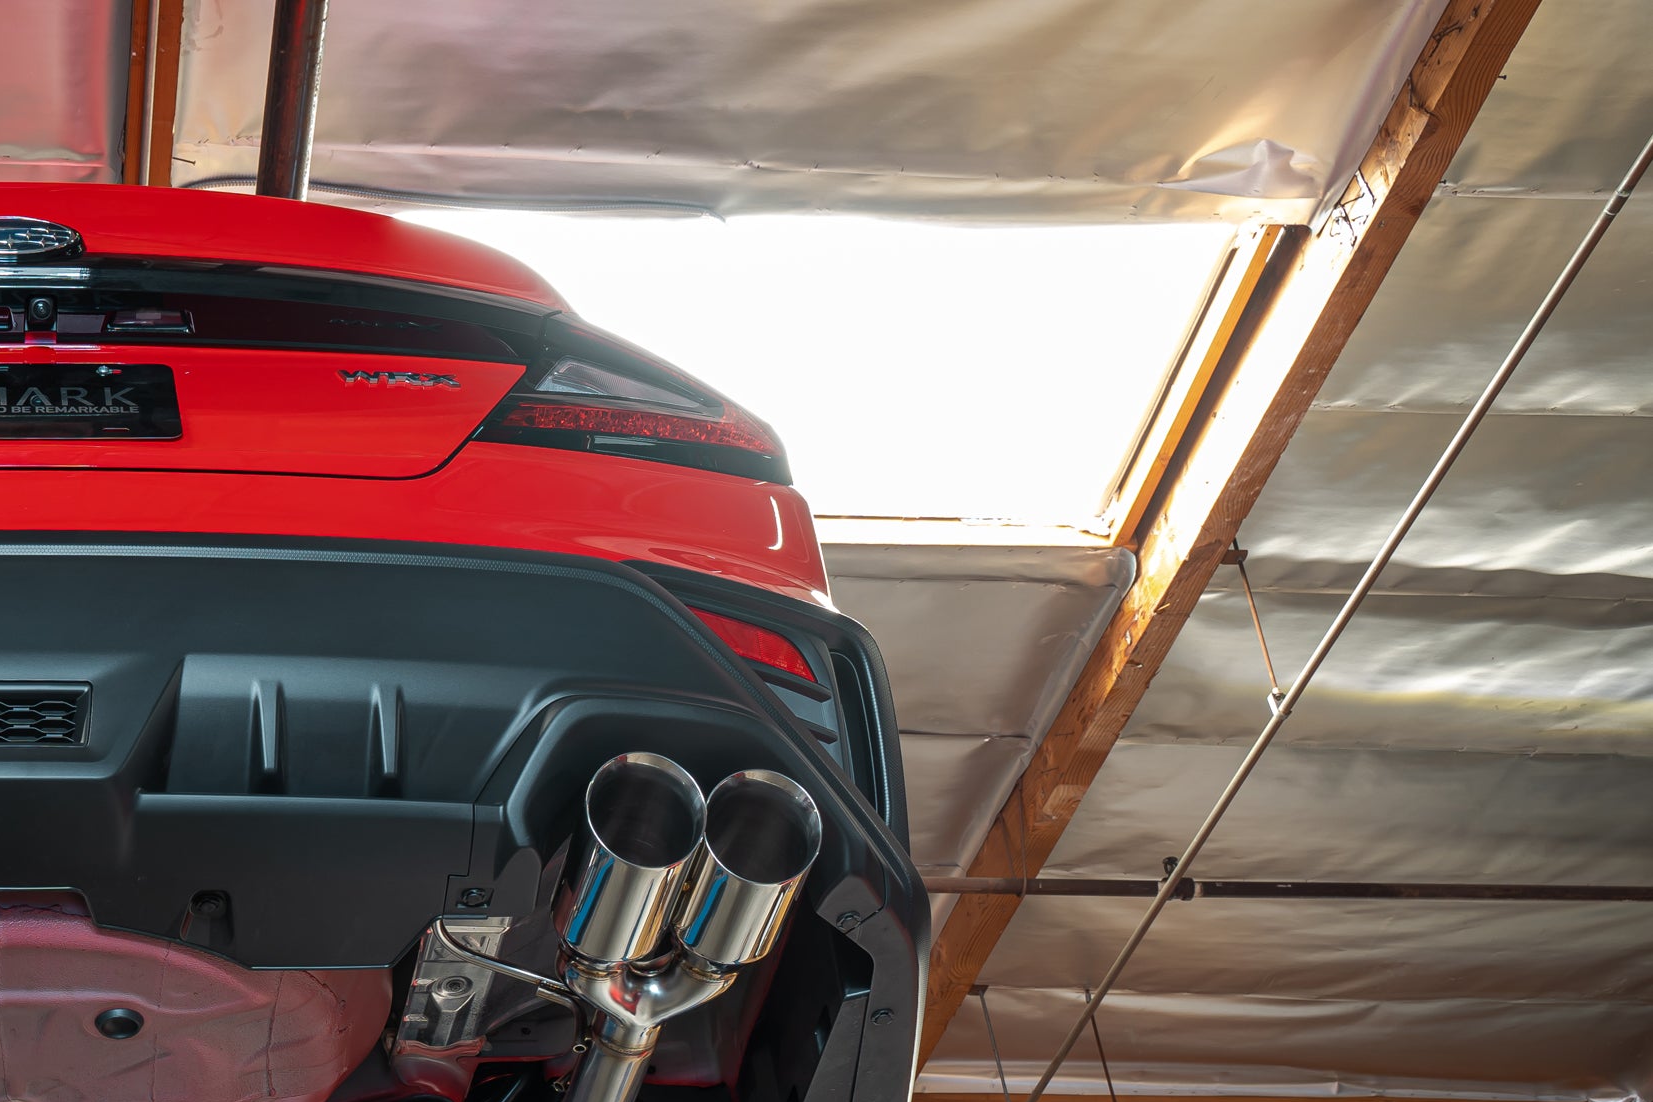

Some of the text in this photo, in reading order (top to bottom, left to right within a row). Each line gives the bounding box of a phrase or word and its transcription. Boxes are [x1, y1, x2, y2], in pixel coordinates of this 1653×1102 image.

[337, 369, 461, 388] WRX
[11, 405, 32, 413] BE
[37, 405, 140, 413] REMARKABLE
